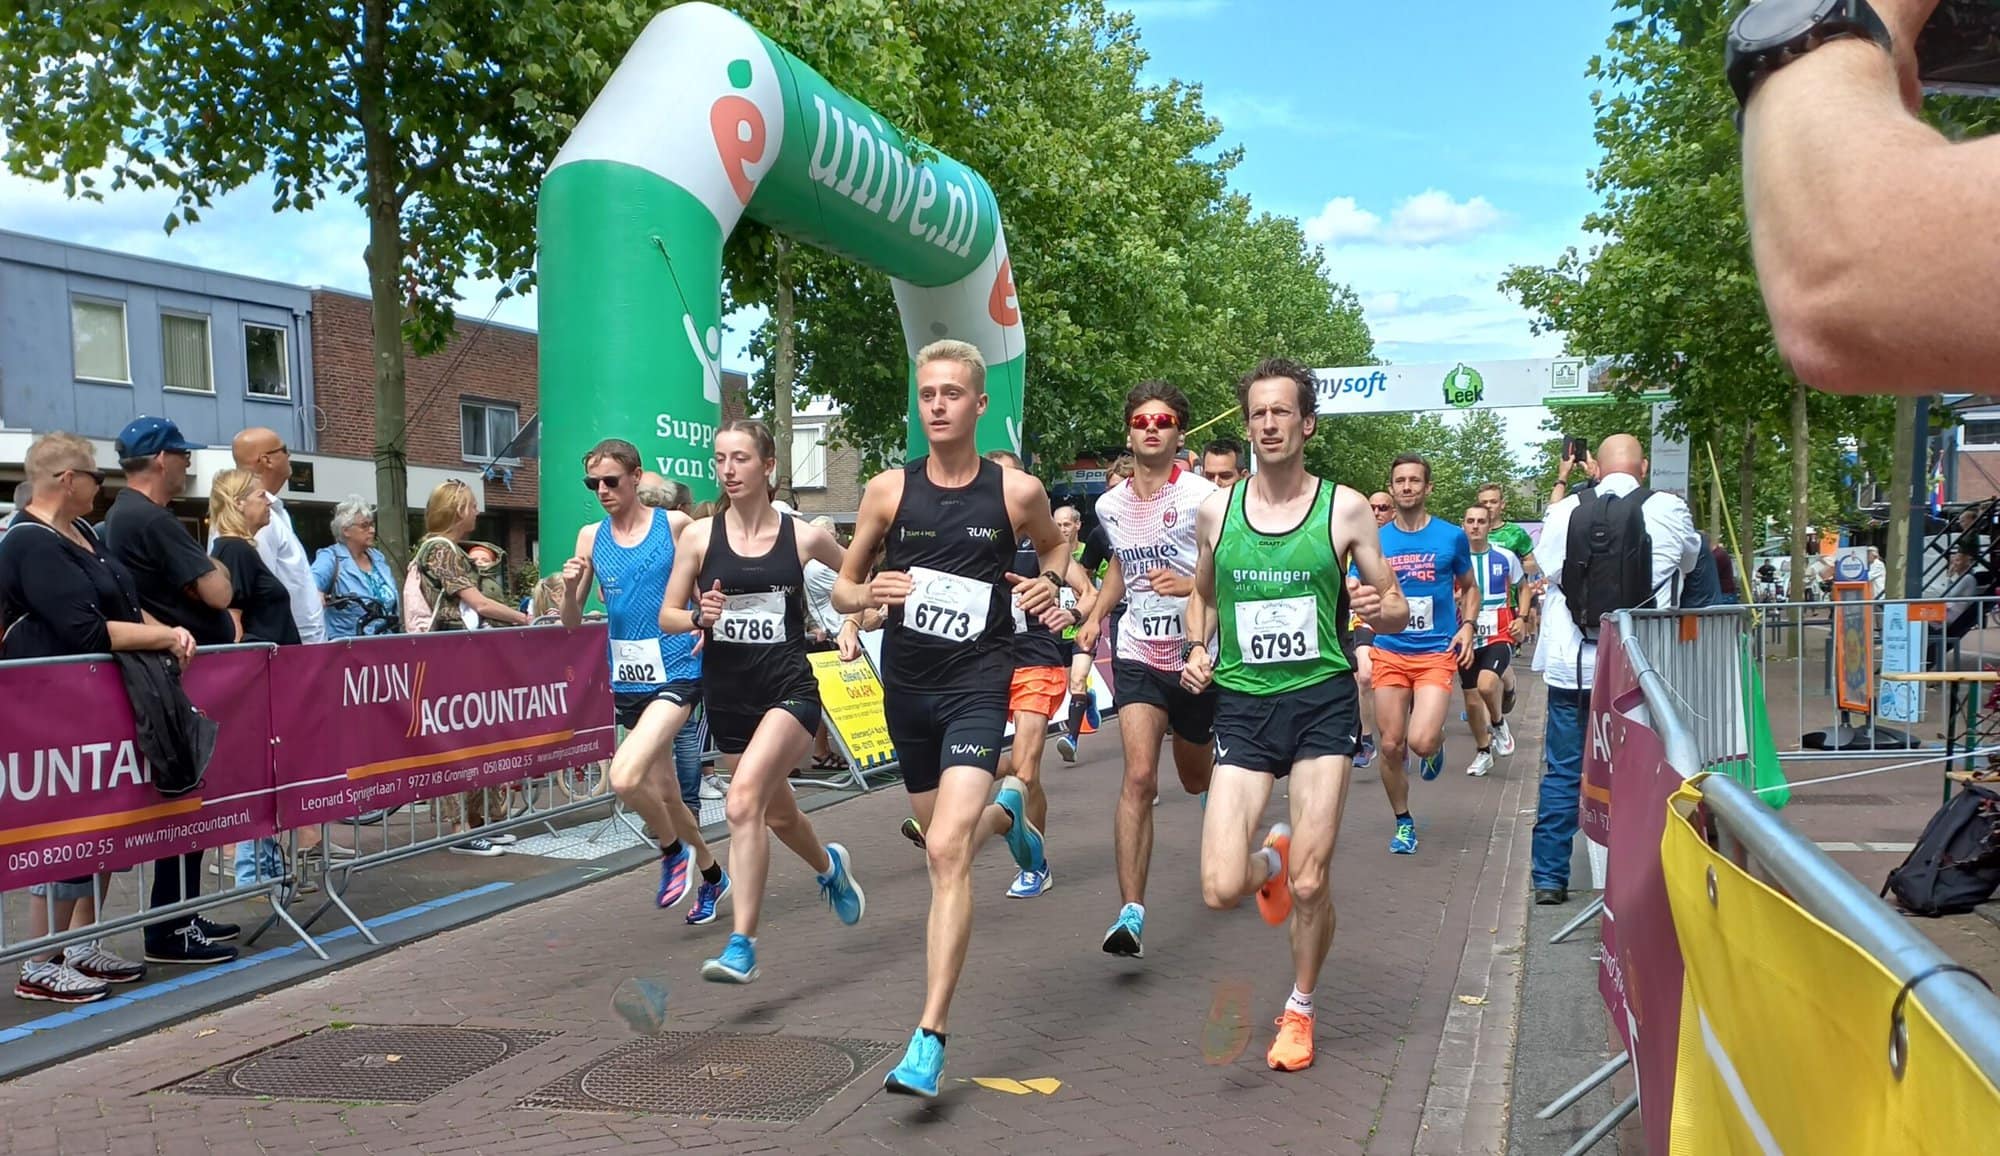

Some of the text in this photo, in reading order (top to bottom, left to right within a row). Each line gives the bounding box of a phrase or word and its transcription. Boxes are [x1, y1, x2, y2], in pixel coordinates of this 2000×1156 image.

[1444, 385, 1484, 404] Leek
[655, 456, 704, 478] van
[632, 549, 662, 581] CRAFT
[1115, 543, 1179, 563] Emirates
[1233, 567, 1311, 584] groningen
[724, 618, 774, 640] 6786
[915, 602, 970, 638] 6773
[1142, 614, 1182, 636] 6771
[1251, 631, 1307, 660] 6793
[343, 662, 410, 707] MIJN
[618, 663, 656, 682] 6802
[420, 681, 569, 737] ACCOUNTANT
[0, 739, 152, 801] UNTA
[301, 791, 344, 811] Leonard
[408, 773, 431, 789] 9727
[431, 770, 443, 785] KB
[444, 764, 479, 781] Groningen
[8, 808, 251, 872] 050 820 02 55 www.mijnaccountant.nl
